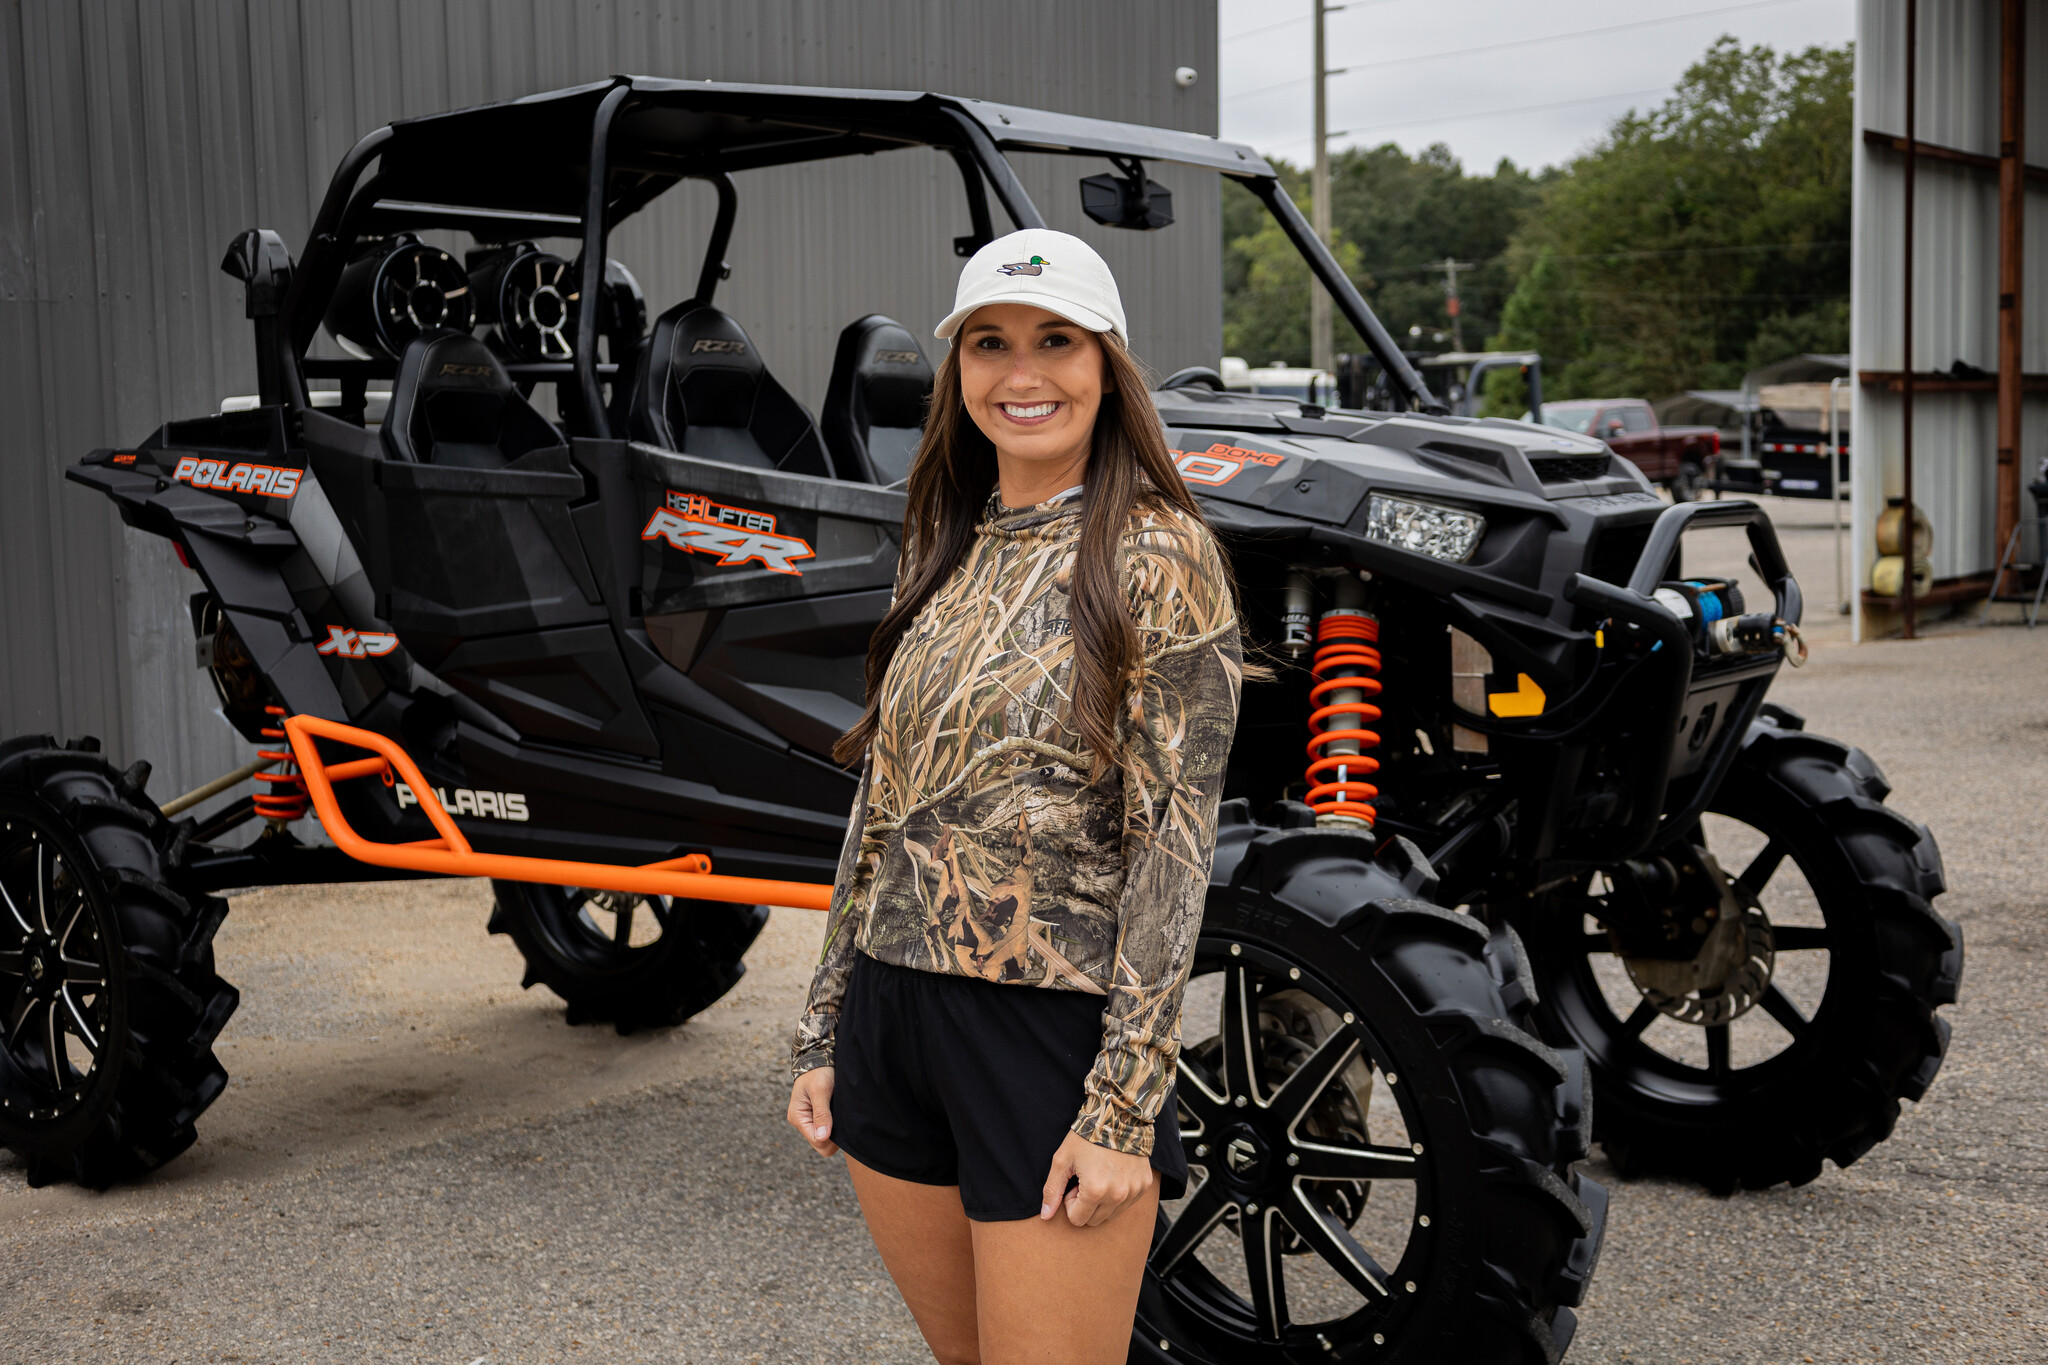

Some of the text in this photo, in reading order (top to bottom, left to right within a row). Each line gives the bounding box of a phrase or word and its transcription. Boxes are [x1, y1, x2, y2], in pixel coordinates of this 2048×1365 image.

[691, 339, 745, 354] RZR
[439, 363, 492, 376] RZR
[1206, 443, 1284, 468] DOHC
[173, 457, 304, 499] POLARIS
[642, 507, 815, 576] RZR
[315, 625, 399, 659] XP
[396, 783, 529, 821] PLARIS
